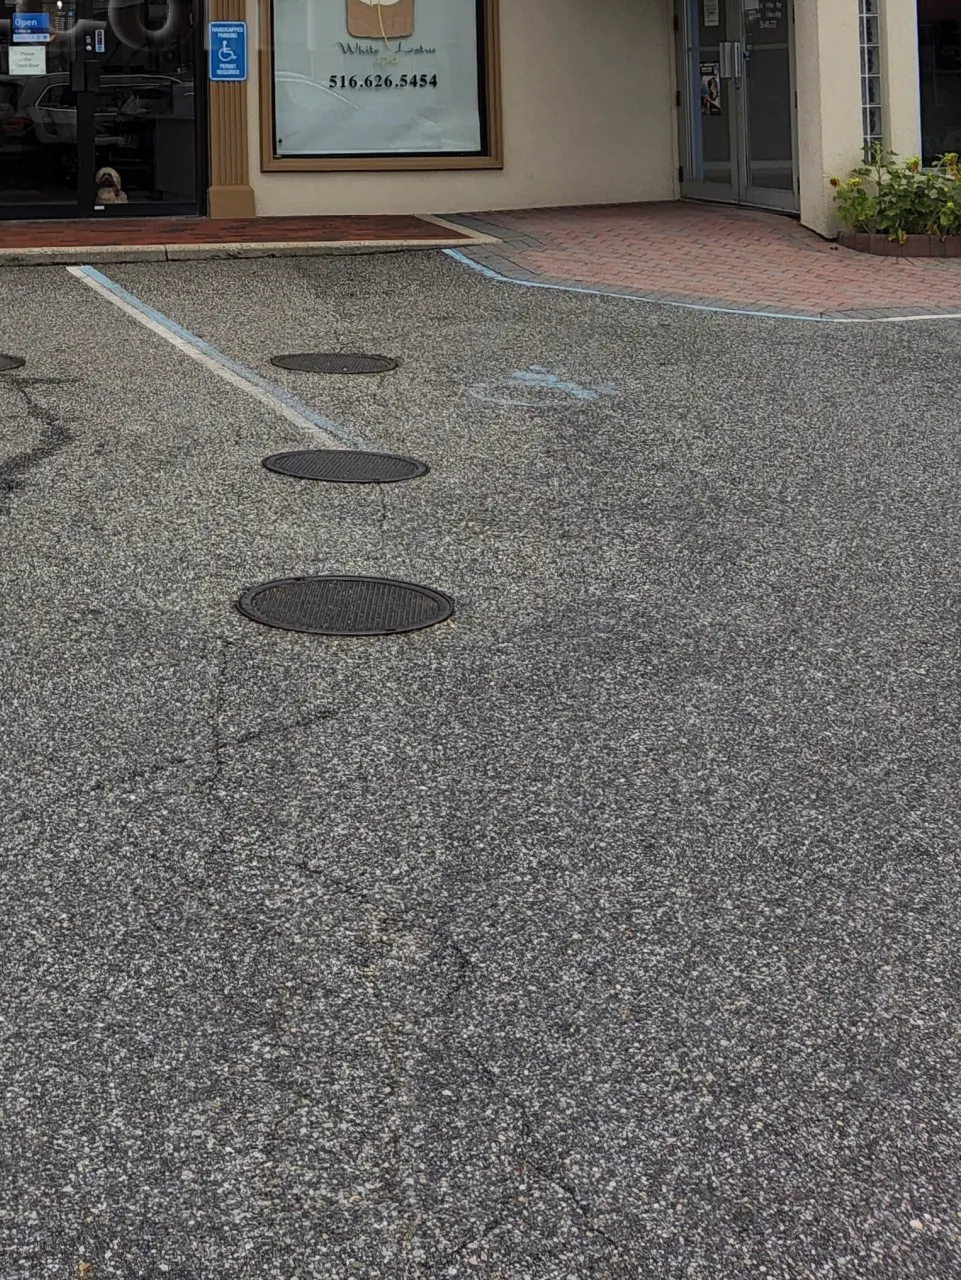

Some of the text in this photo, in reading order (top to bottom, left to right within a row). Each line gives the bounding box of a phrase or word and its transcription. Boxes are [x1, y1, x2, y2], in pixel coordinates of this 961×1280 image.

[14, 19, 38, 28] Open
[338, 41, 436, 55] White Lotus
[328, 74, 438, 89] 516.626.5454
